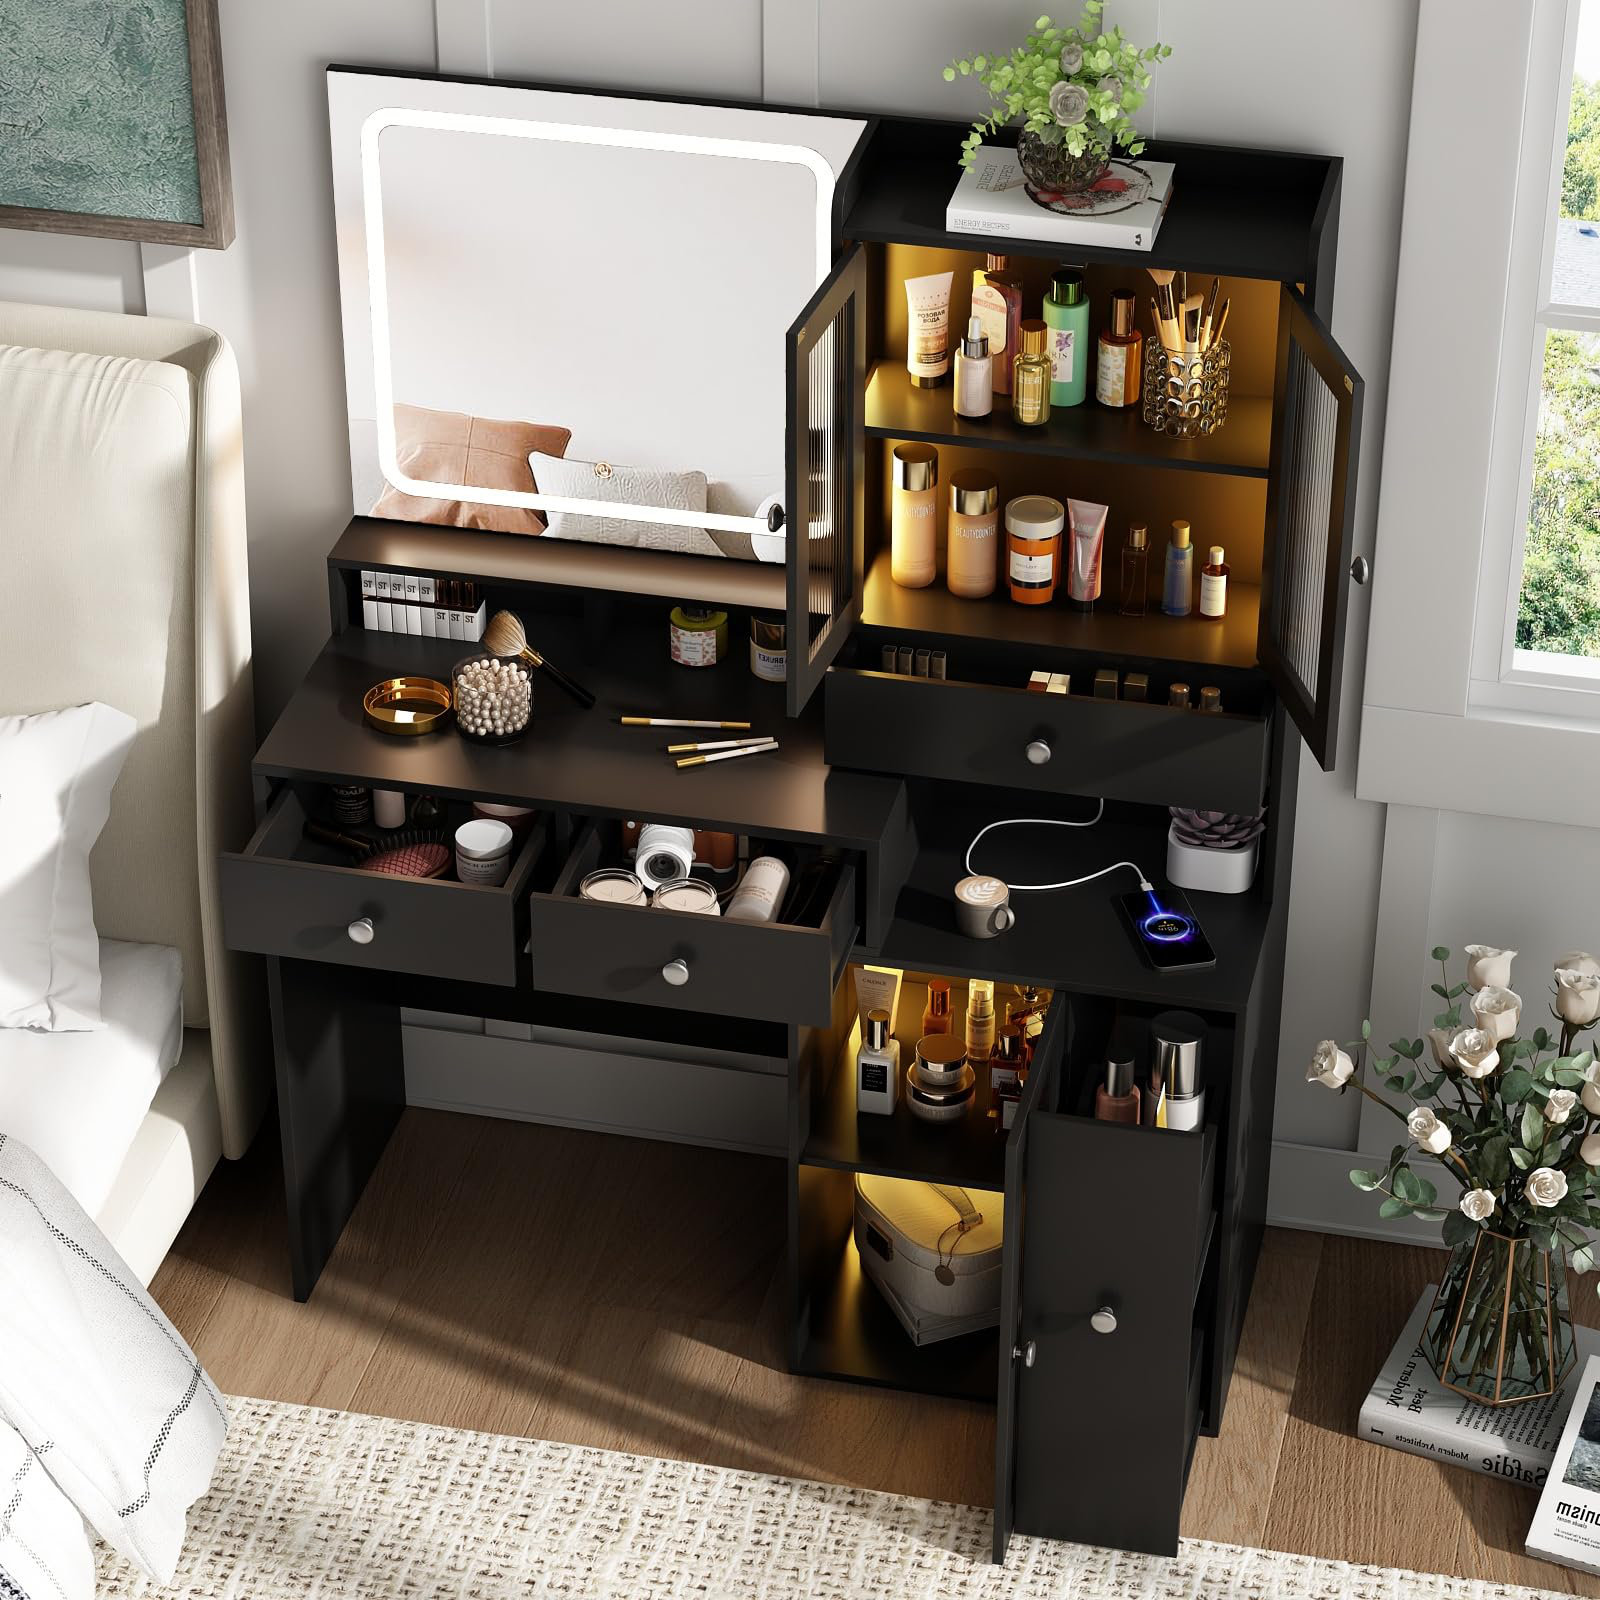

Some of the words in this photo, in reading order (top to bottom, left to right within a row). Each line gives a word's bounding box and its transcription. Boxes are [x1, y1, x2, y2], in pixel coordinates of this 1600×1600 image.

[976, 163, 998, 190] ENERGY
[993, 164, 1015, 192] RECIPES
[954, 218, 981, 228] ENERGY
[982, 221, 1010, 230] RECIPES
[917, 309, 946, 319] РОЗОВАЯ
[923, 316, 940, 324] ВОДА
[364, 580, 372, 588] ST
[378, 582, 387, 590] ST
[392, 583, 402, 591] ST
[407, 585, 416, 593] ST
[421, 586, 431, 595] ST
[437, 612, 446, 620] ST
[451, 613, 460, 621] ST
[465, 615, 474, 623] ST
